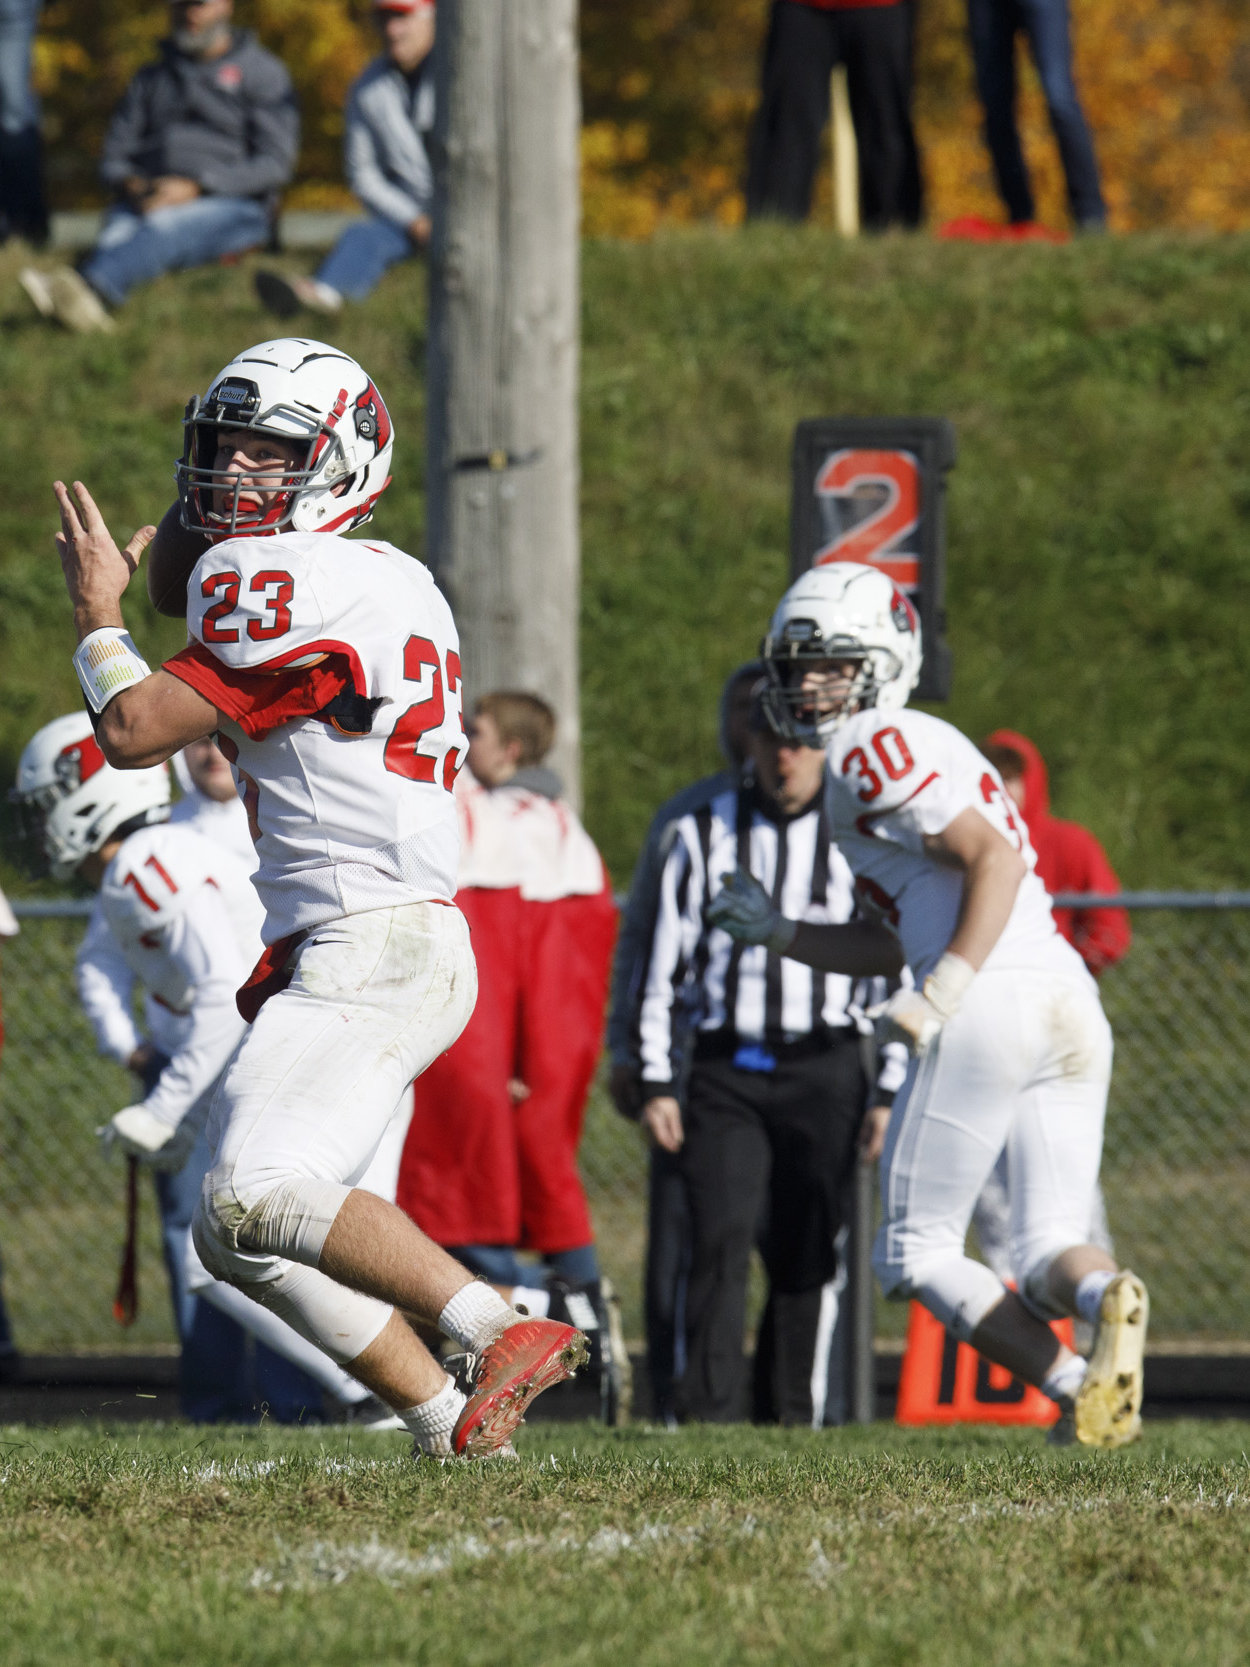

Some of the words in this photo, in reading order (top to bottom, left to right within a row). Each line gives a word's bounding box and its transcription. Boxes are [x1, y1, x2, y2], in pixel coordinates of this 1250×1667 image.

[219, 390, 245, 400] schutt
[816, 447, 921, 592] 2
[201, 570, 295, 644] 23
[841, 726, 915, 801] 30
[123, 855, 178, 912] 11
